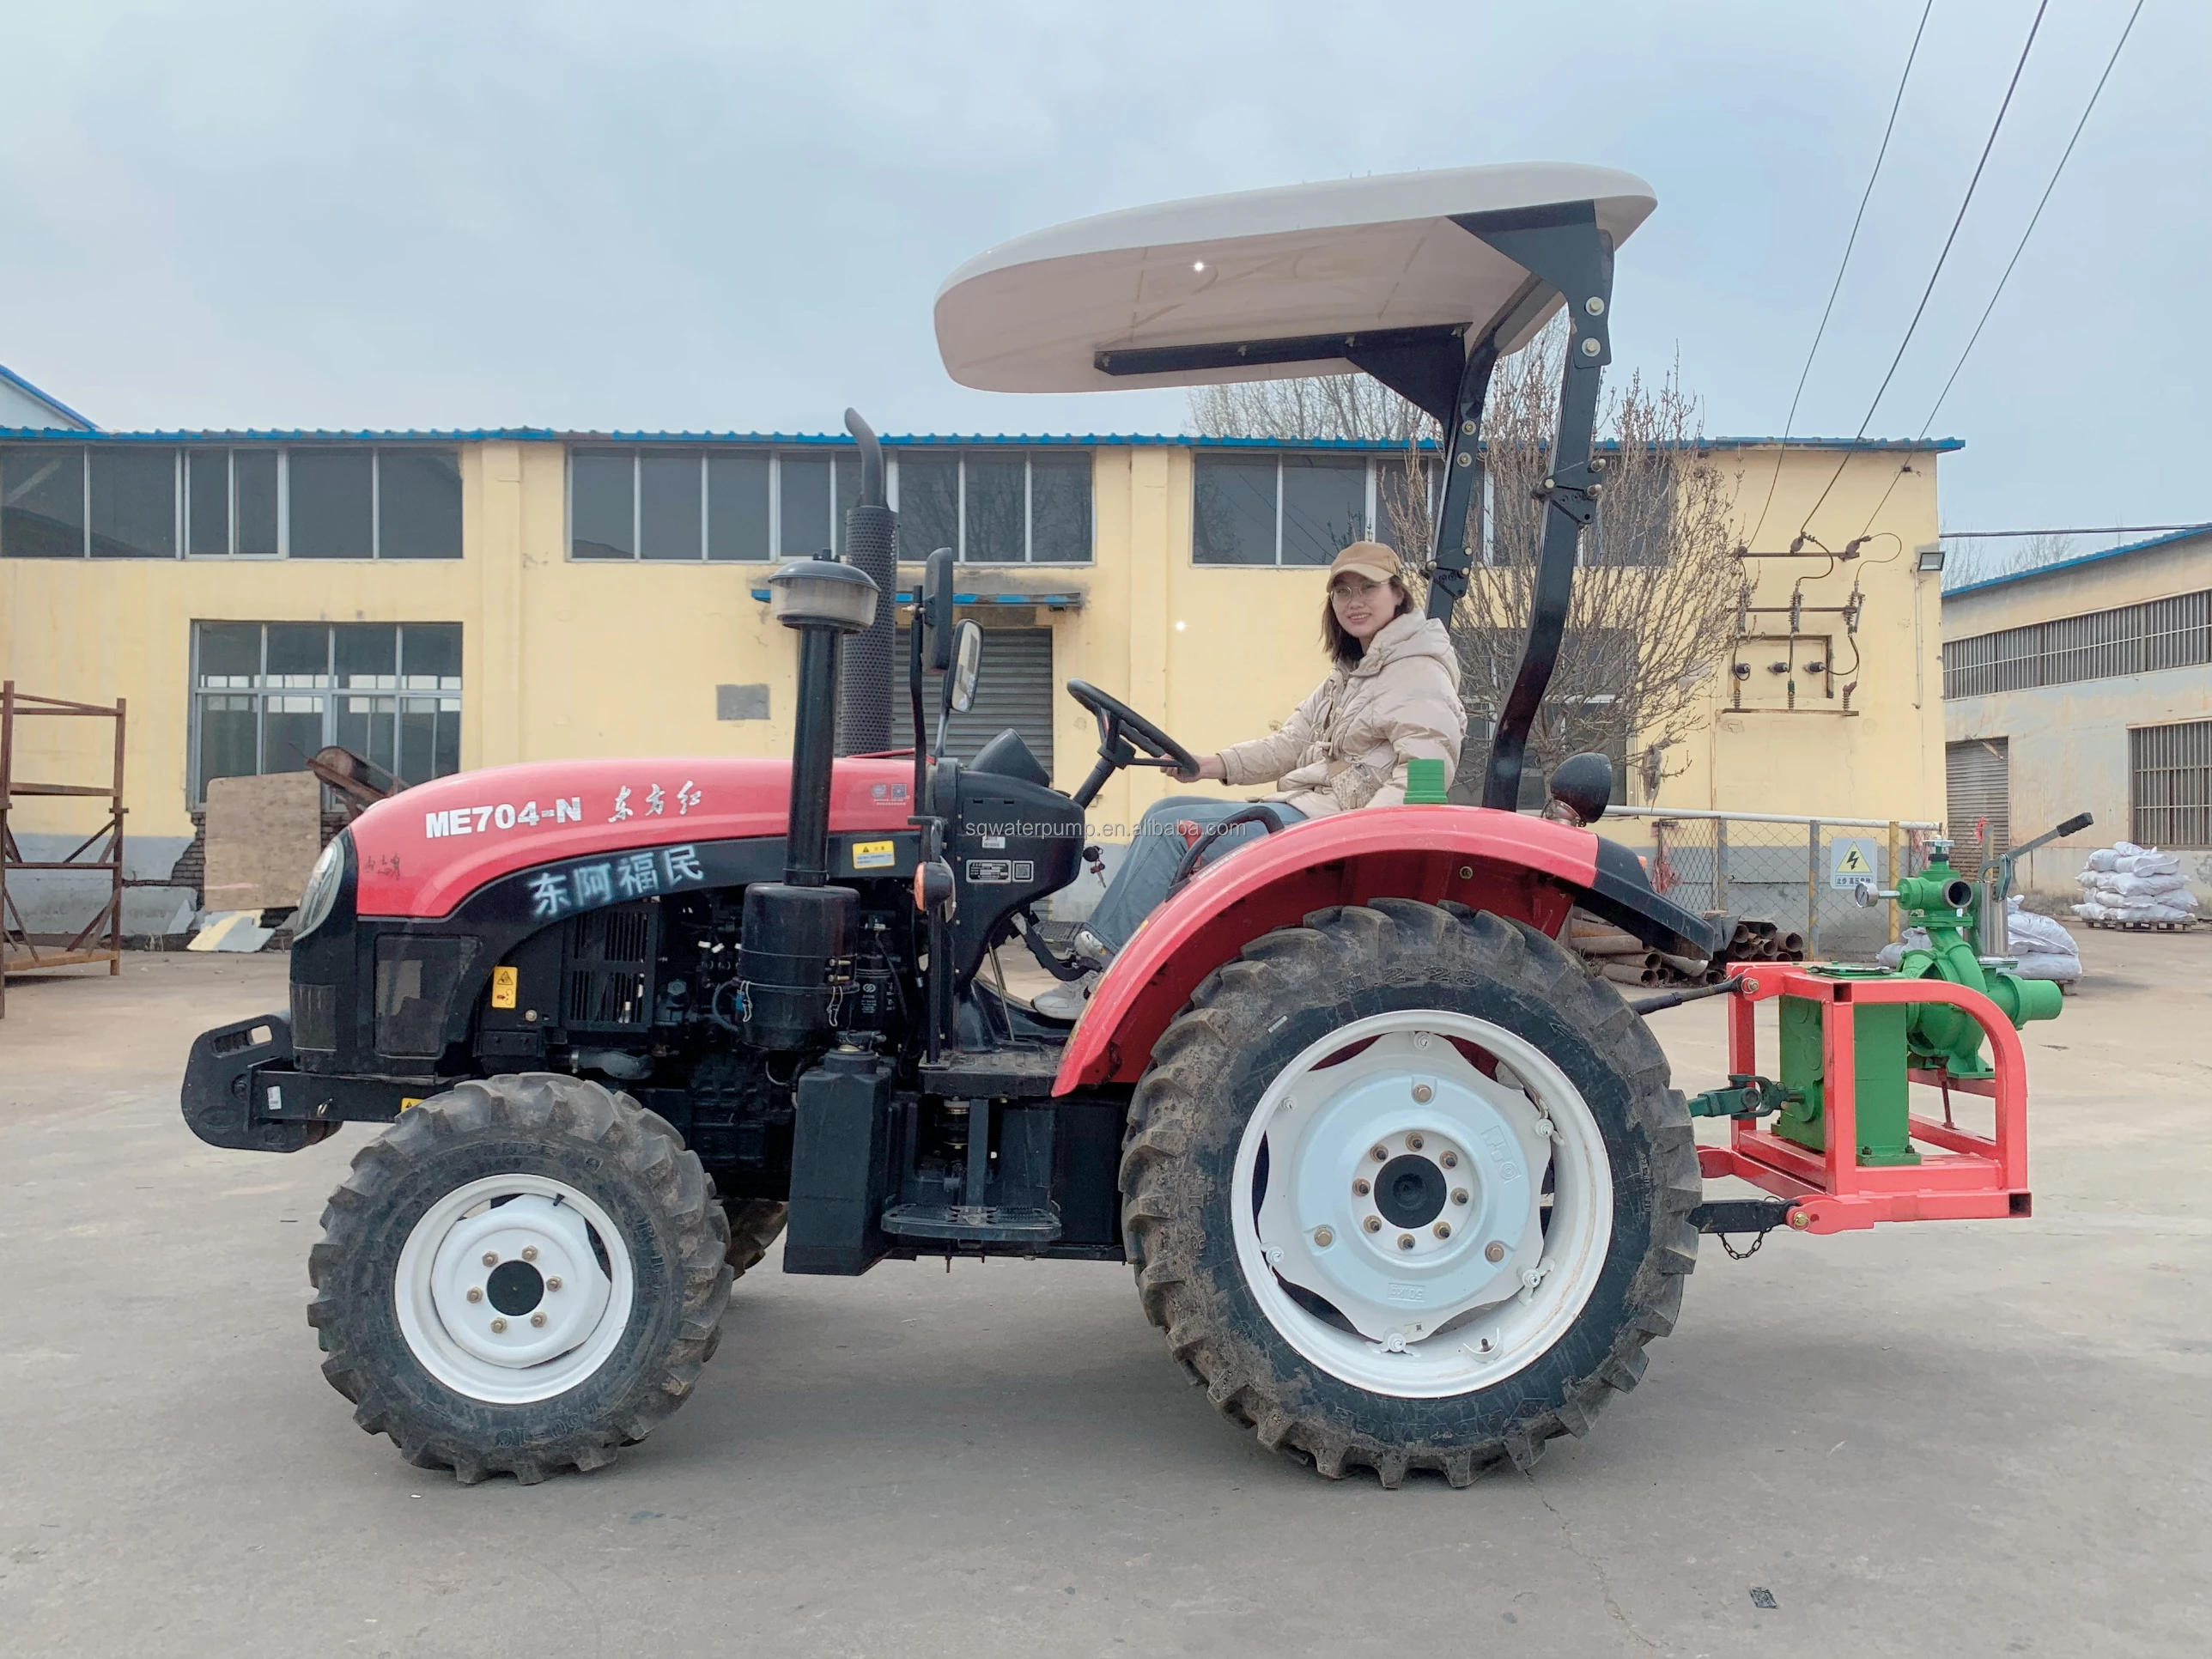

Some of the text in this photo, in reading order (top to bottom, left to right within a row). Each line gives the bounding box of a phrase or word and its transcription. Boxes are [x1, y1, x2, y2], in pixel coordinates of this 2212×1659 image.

[425, 797, 582, 838] ME704-N
[608, 780, 702, 823] 东方红
[527, 845, 705, 918] 东阿福民
